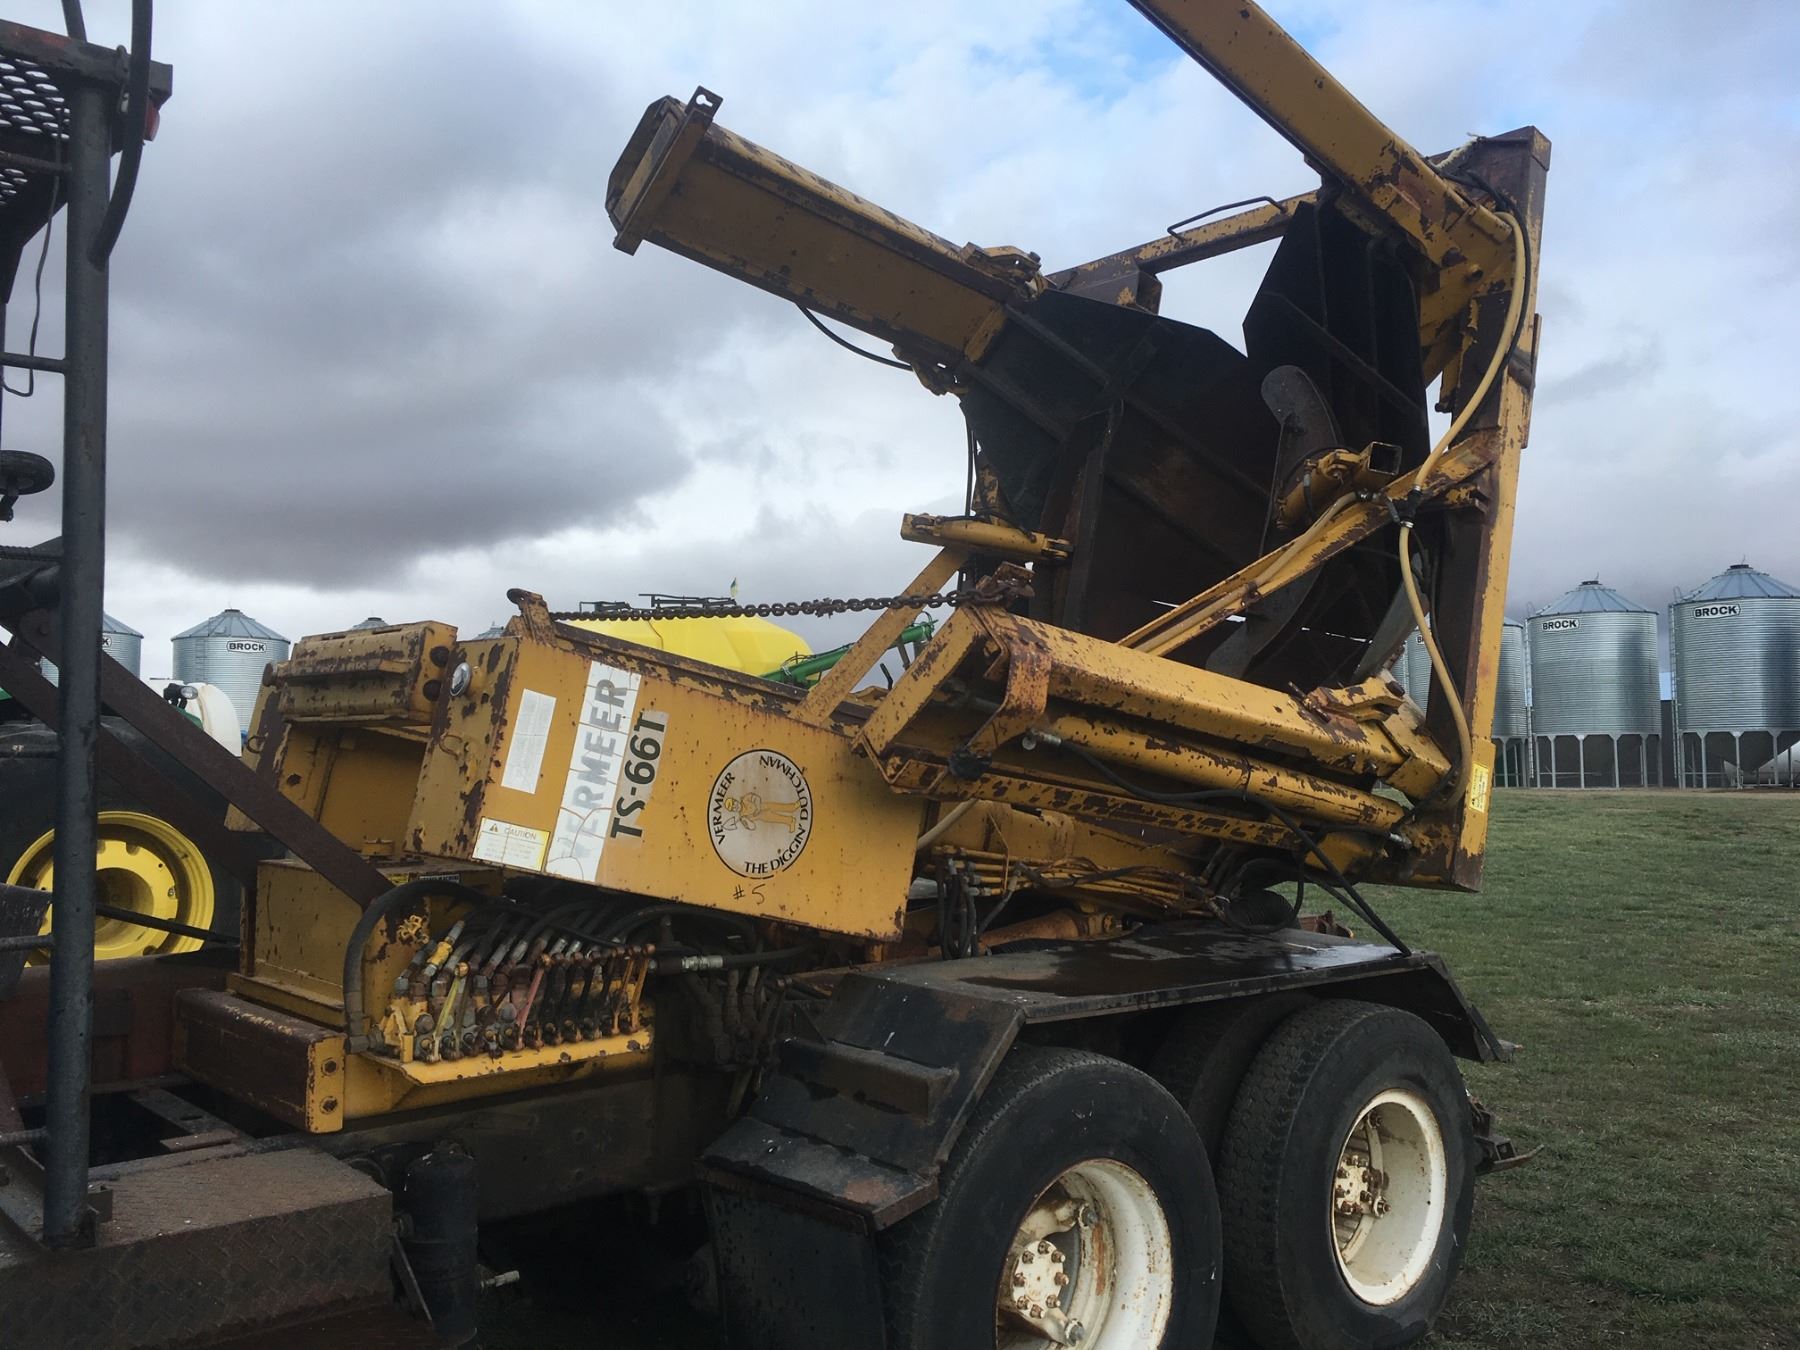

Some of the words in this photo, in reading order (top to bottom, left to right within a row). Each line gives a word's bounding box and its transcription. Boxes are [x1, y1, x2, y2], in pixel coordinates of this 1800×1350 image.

[1694, 605, 1738, 618] BROCK
[1542, 619, 1577, 631] BROCK
[228, 642, 265, 652] BROCK
[610, 712, 665, 838] TS-66T
[759, 755, 809, 821] DUTCHMAN
[713, 772, 735, 845] VERMEER
[504, 827, 537, 840] CAUTION
[770, 823, 806, 871] DIGGIN'
[744, 861, 769, 874] THE
